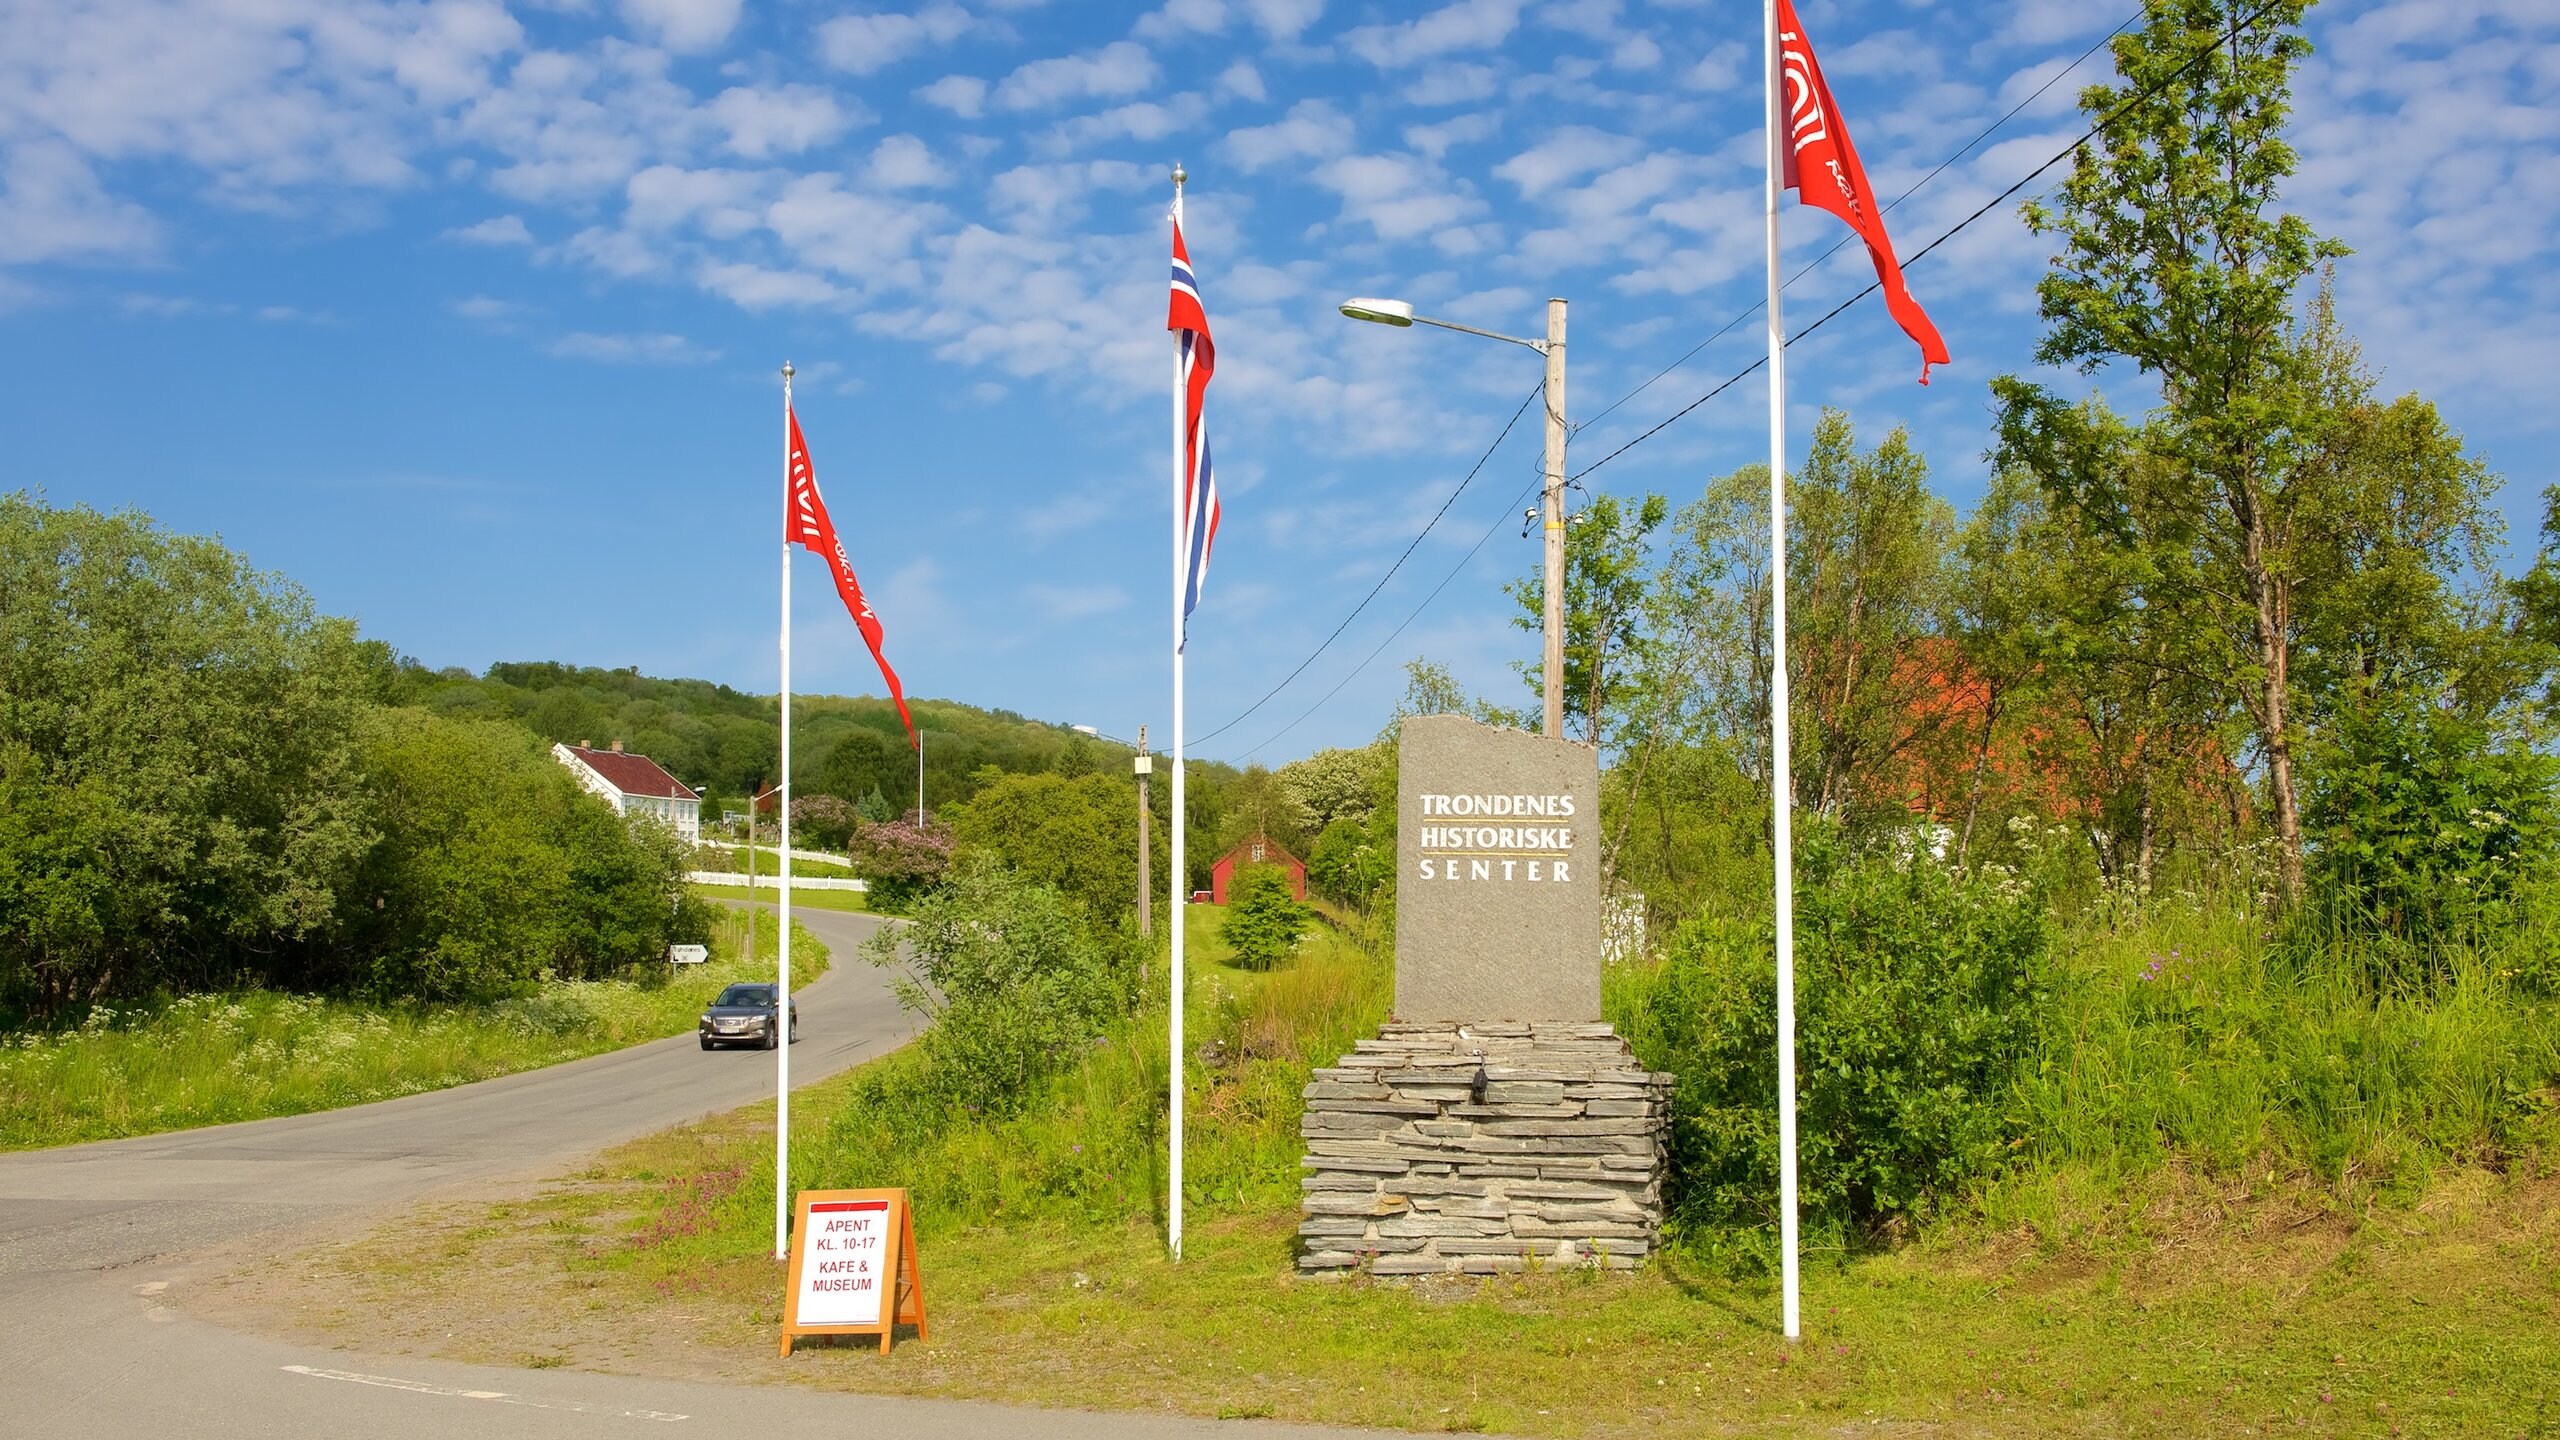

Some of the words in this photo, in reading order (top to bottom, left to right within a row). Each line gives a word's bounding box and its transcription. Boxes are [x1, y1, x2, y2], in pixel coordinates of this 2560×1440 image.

[1420, 795, 1575, 816] TRONDENES
[1420, 828, 1573, 849] HISTORISKE
[1419, 860, 1571, 882] SENTER
[817, 1239, 838, 1250] KL.
[843, 1237, 876, 1250] 10-17
[819, 1261, 855, 1274] KAFE
[859, 1260, 868, 1273] &
[812, 1278, 872, 1292] MUSEUM
